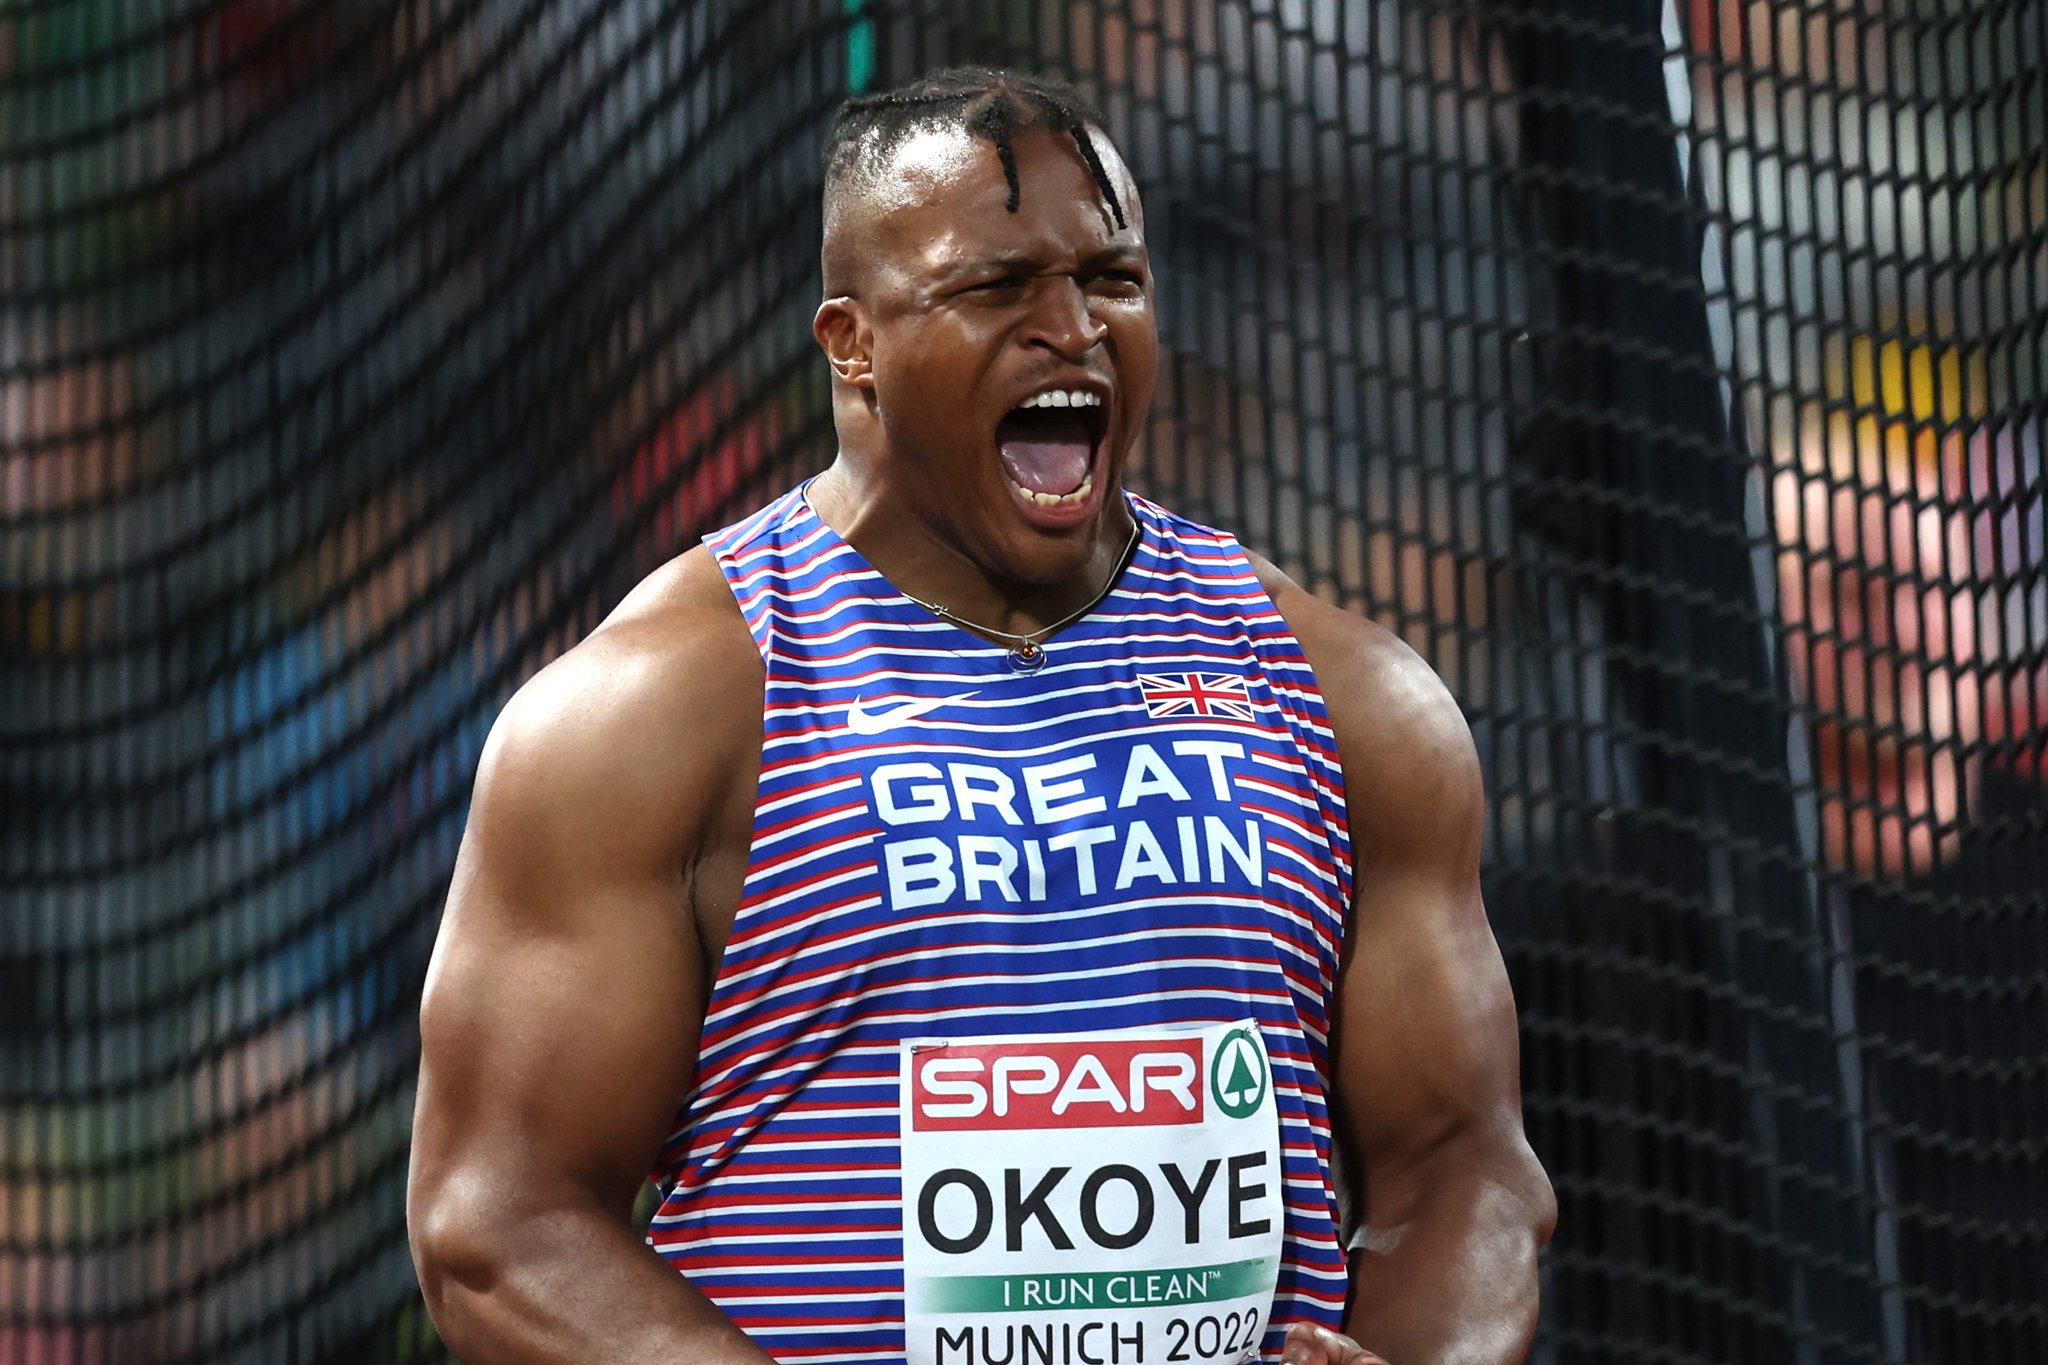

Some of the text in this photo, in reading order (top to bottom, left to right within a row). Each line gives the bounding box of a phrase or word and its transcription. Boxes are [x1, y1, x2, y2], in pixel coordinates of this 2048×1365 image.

[870, 740, 1245, 826] GREAT
[884, 816, 1263, 911] BRITAIN
[920, 1052, 1196, 1118] SPAR
[917, 1150, 1271, 1255] OKOYE
[1003, 1280, 1011, 1307] I
[1023, 1277, 1094, 1306] RUN
[935, 1307, 1259, 1365] MUNICH 2022
